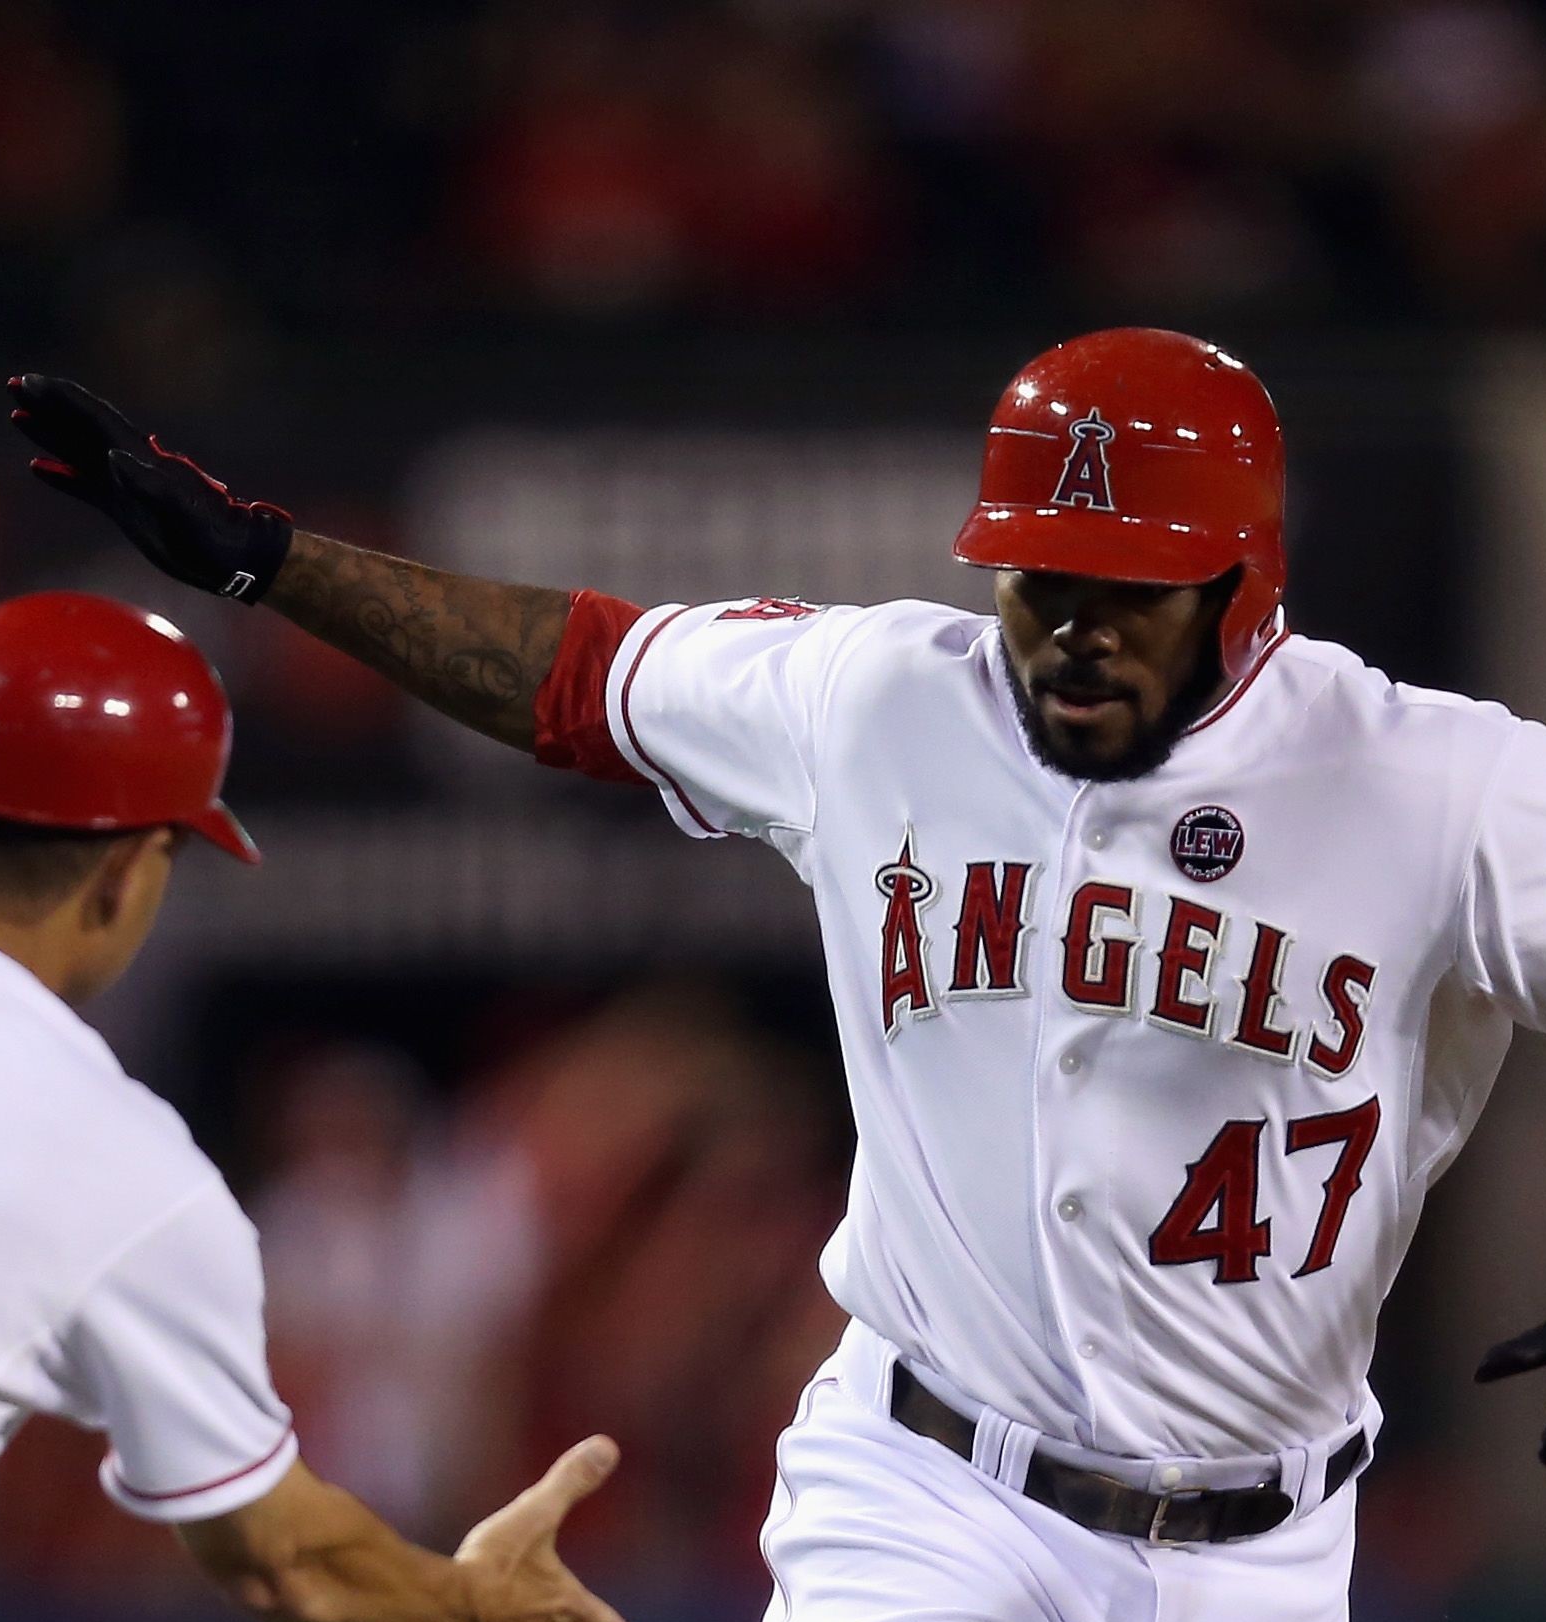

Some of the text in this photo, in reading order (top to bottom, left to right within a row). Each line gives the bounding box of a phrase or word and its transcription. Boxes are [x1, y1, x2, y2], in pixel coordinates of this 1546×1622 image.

[1050, 406, 1116, 511] A
[1175, 826, 1241, 859] LEW
[874, 818, 1379, 1082] ANGELS
[1148, 1093, 1383, 1287] 47
